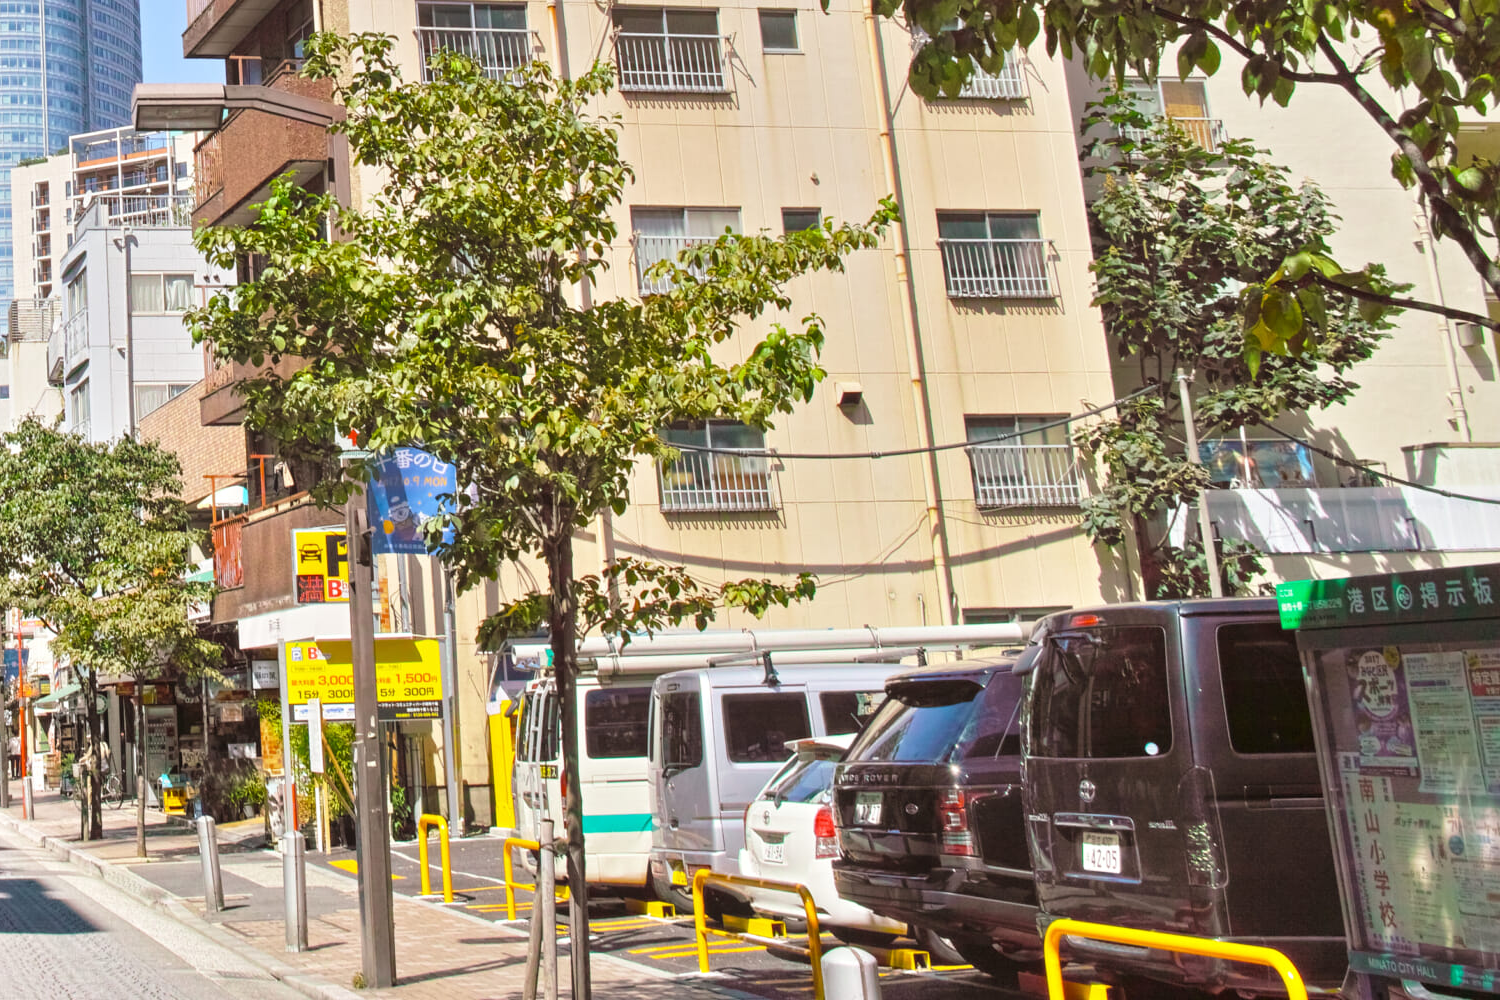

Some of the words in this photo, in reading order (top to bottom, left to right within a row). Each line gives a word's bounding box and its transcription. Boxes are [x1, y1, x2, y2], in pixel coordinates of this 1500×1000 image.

[376, 448, 449, 475] 十番の日
[423, 475, 448, 487] MON
[1347, 586, 1390, 614] 港区
[1420, 577, 1494, 609] 掲示板
[395, 673, 438, 686] 1,500円
[404, 687, 435, 696] 300円
[863, 773, 899, 783] ROVER
[1090, 848, 1118, 870] 42-05
[1358, 777, 1397, 929] 南山小学校
[1368, 957, 1397, 973] MINATO
[1398, 961, 1415, 976] CITY
[1416, 964, 1437, 979] HALL
